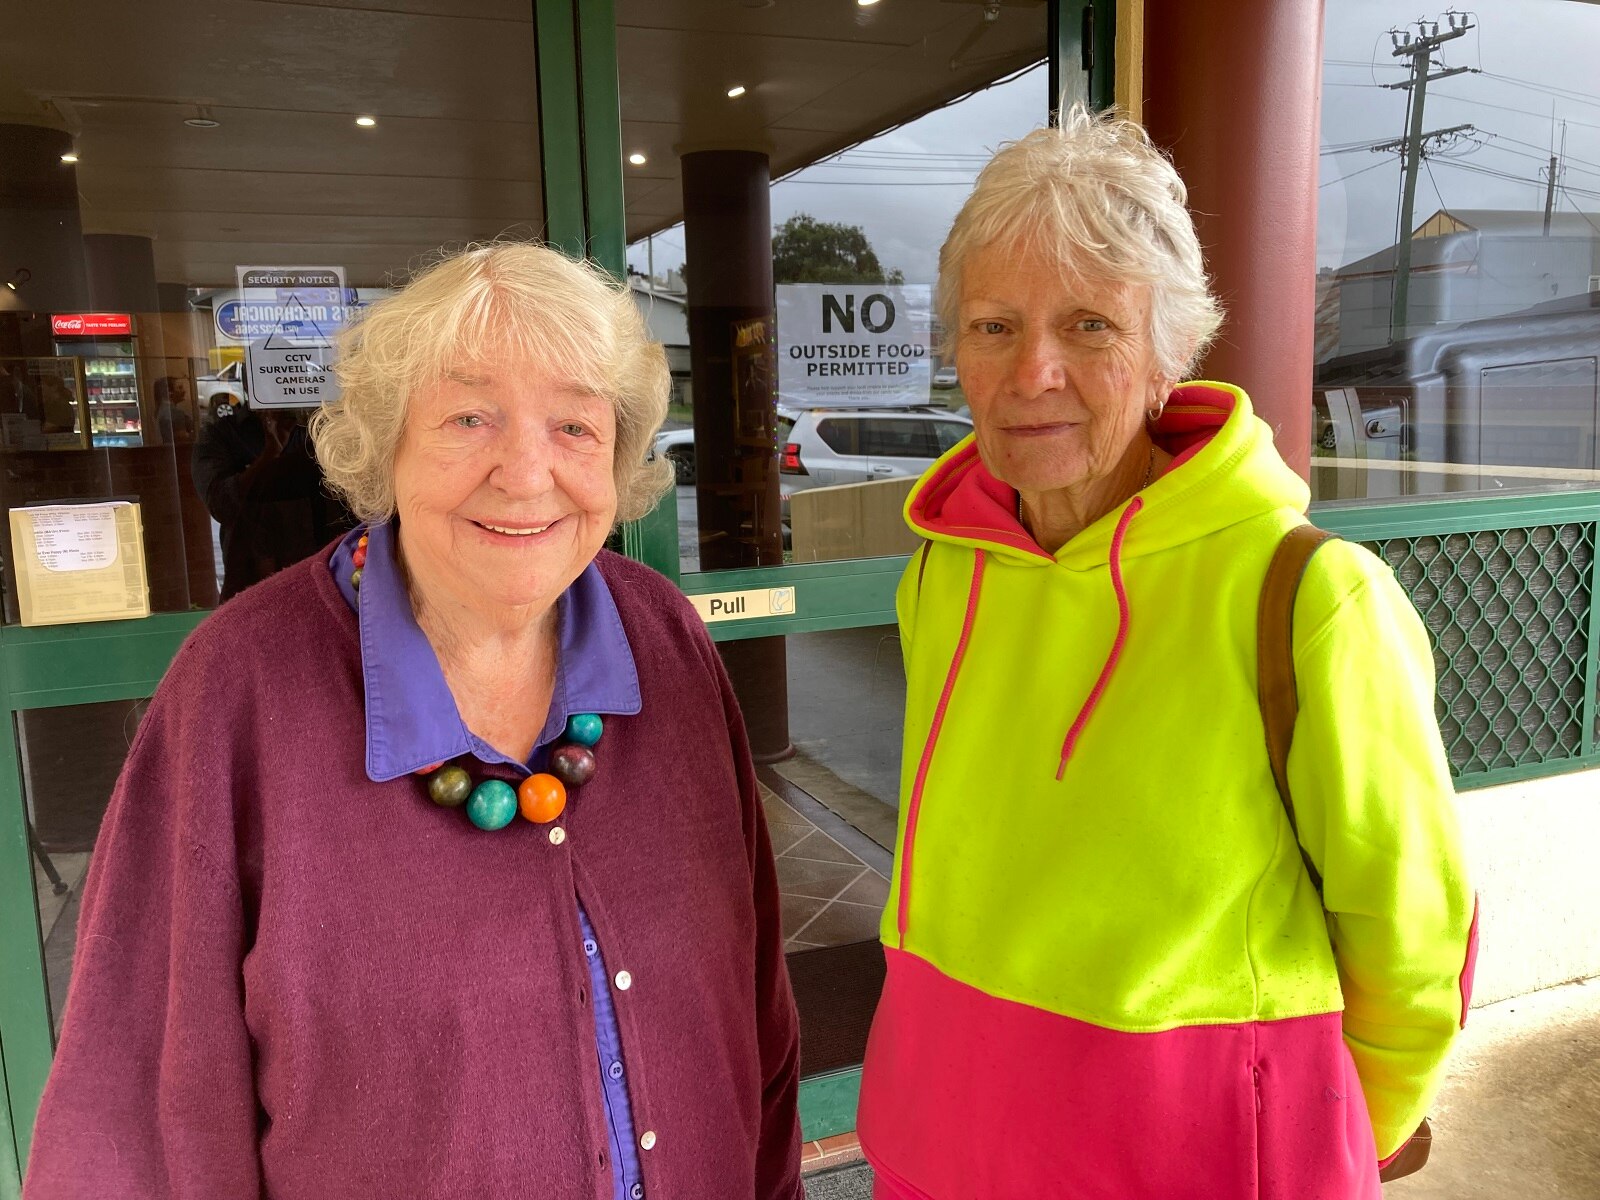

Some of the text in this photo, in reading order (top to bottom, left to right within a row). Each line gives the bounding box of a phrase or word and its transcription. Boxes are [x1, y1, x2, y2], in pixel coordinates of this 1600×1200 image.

[248, 276, 335, 284] SECURITY NOTICE
[821, 293, 896, 334] NO
[789, 344, 925, 359] OUTSIDE FOOD
[285, 354, 312, 362] CCTV
[259, 364, 334, 374] SURVEILLANC
[807, 361, 910, 377] PERMITTED
[275, 376, 326, 385] CAMERAS
[283, 386, 320, 395] IN USE
[710, 596, 746, 616] Pull
